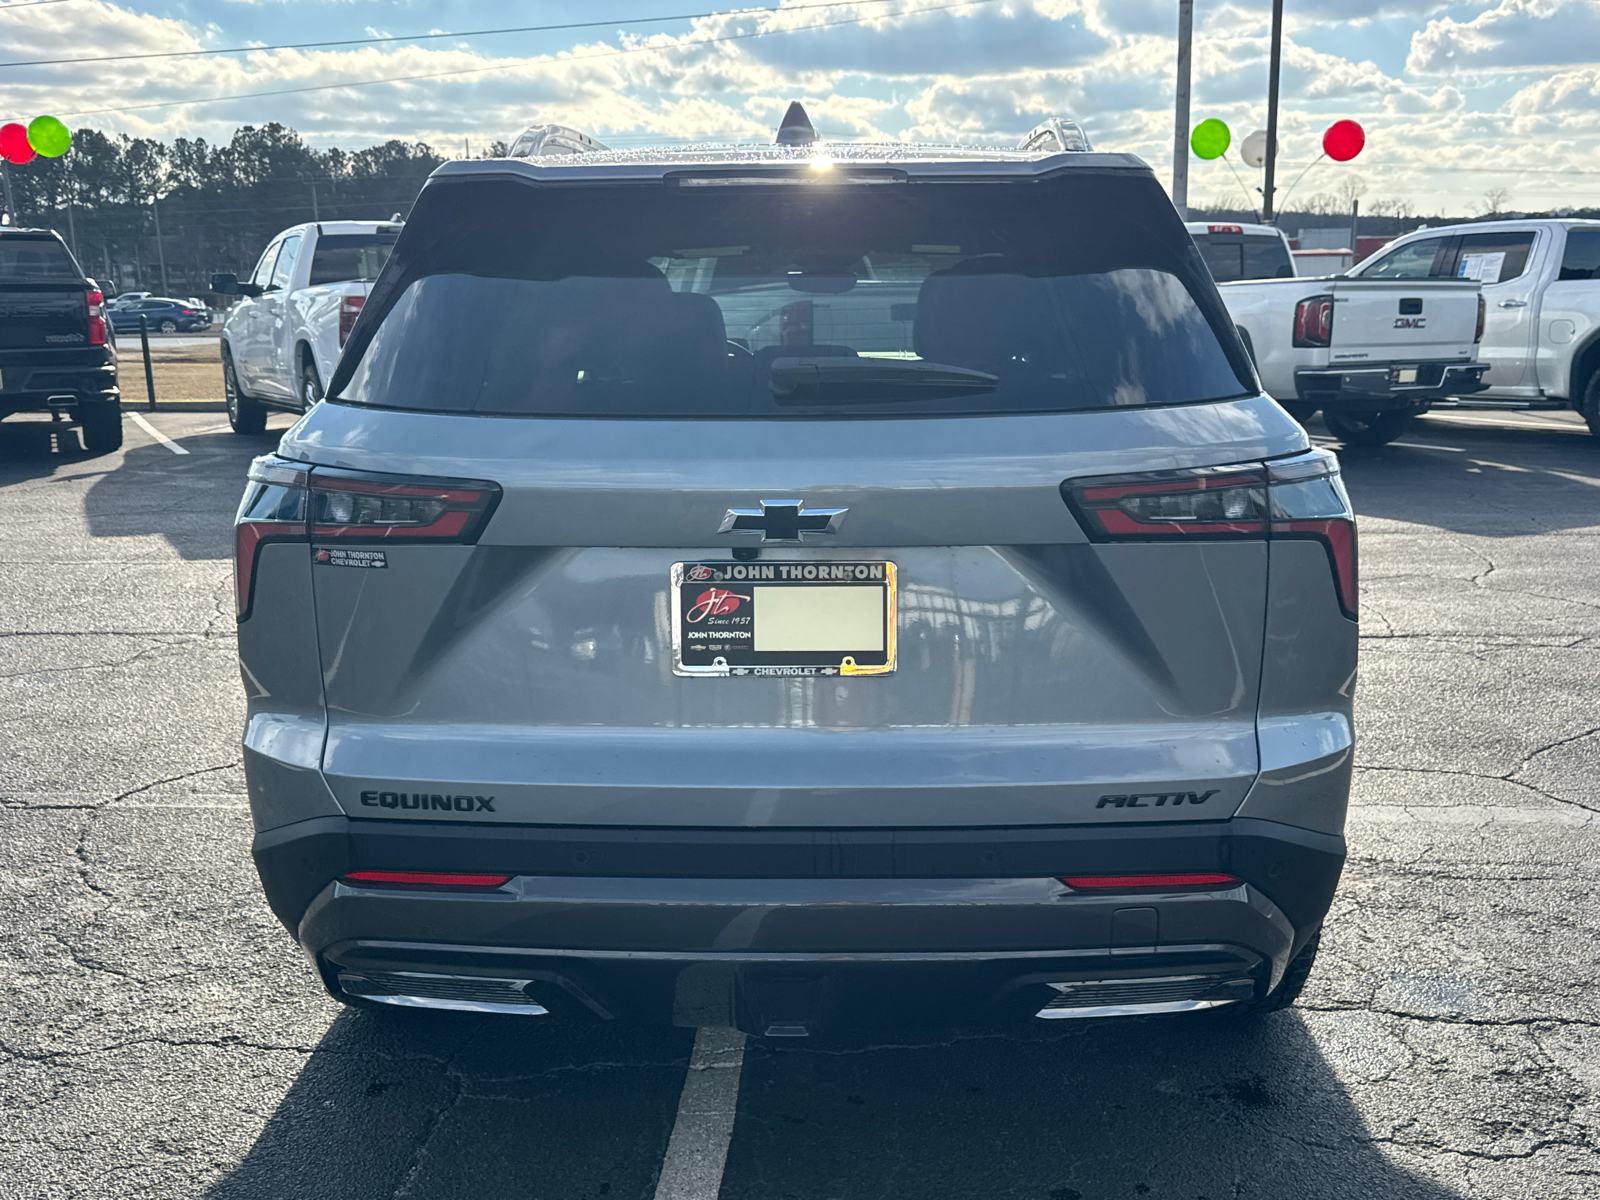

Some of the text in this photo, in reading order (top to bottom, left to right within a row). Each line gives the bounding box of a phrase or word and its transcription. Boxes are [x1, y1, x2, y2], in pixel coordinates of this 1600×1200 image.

[1393, 318, 1427, 328] GMC
[331, 550, 385, 560] JOHN THORNTON
[331, 558, 371, 567] CHEVROLET
[724, 565, 883, 579] JOHN THORNTON
[707, 617, 751, 625] Since 1957
[688, 631, 751, 639] JOHN THORNTON
[360, 790, 496, 812] EQUINOX
[1096, 789, 1221, 809] ACTIV
